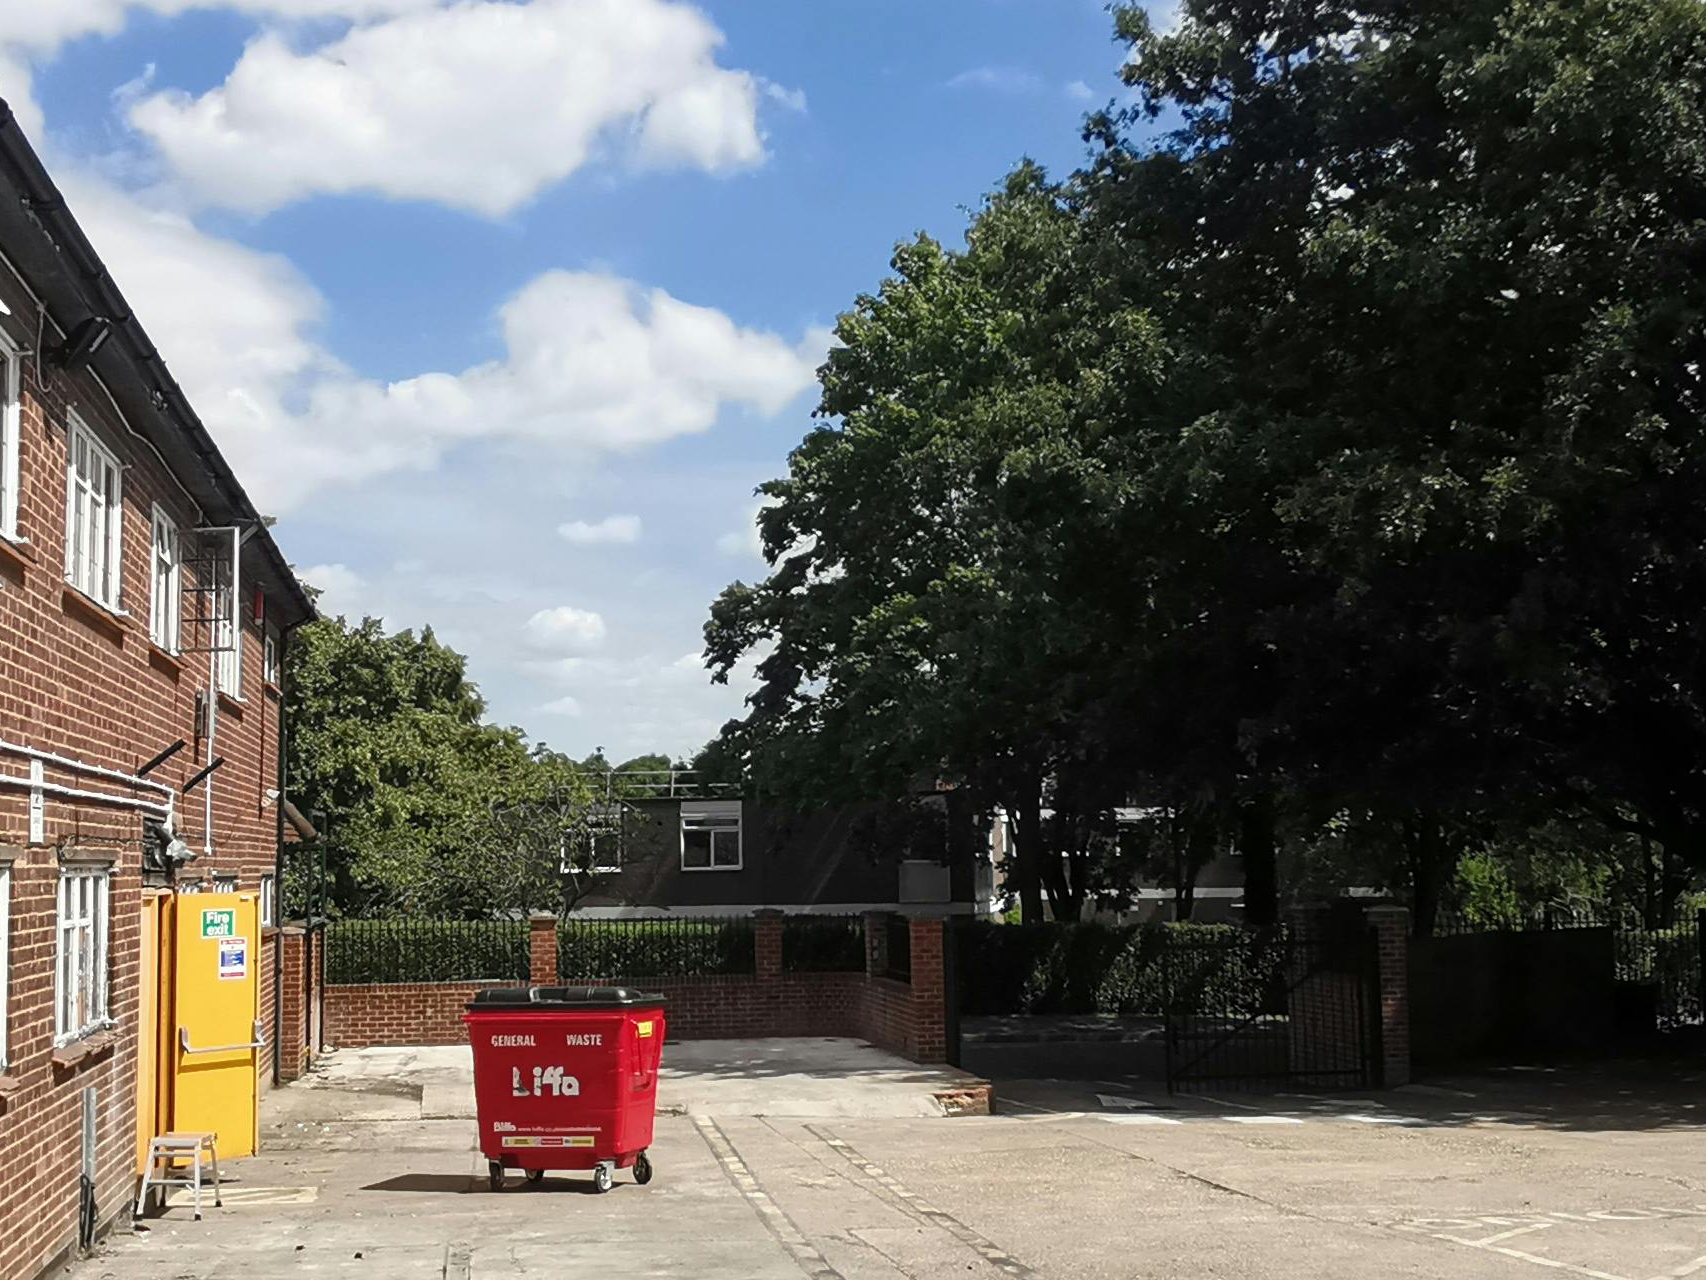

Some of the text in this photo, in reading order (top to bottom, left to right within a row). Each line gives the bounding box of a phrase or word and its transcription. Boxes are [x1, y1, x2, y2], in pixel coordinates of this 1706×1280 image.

[206, 911, 230, 924] Fire
[206, 924, 229, 935] exit
[491, 1034, 602, 1047] GENERAL WASTE
